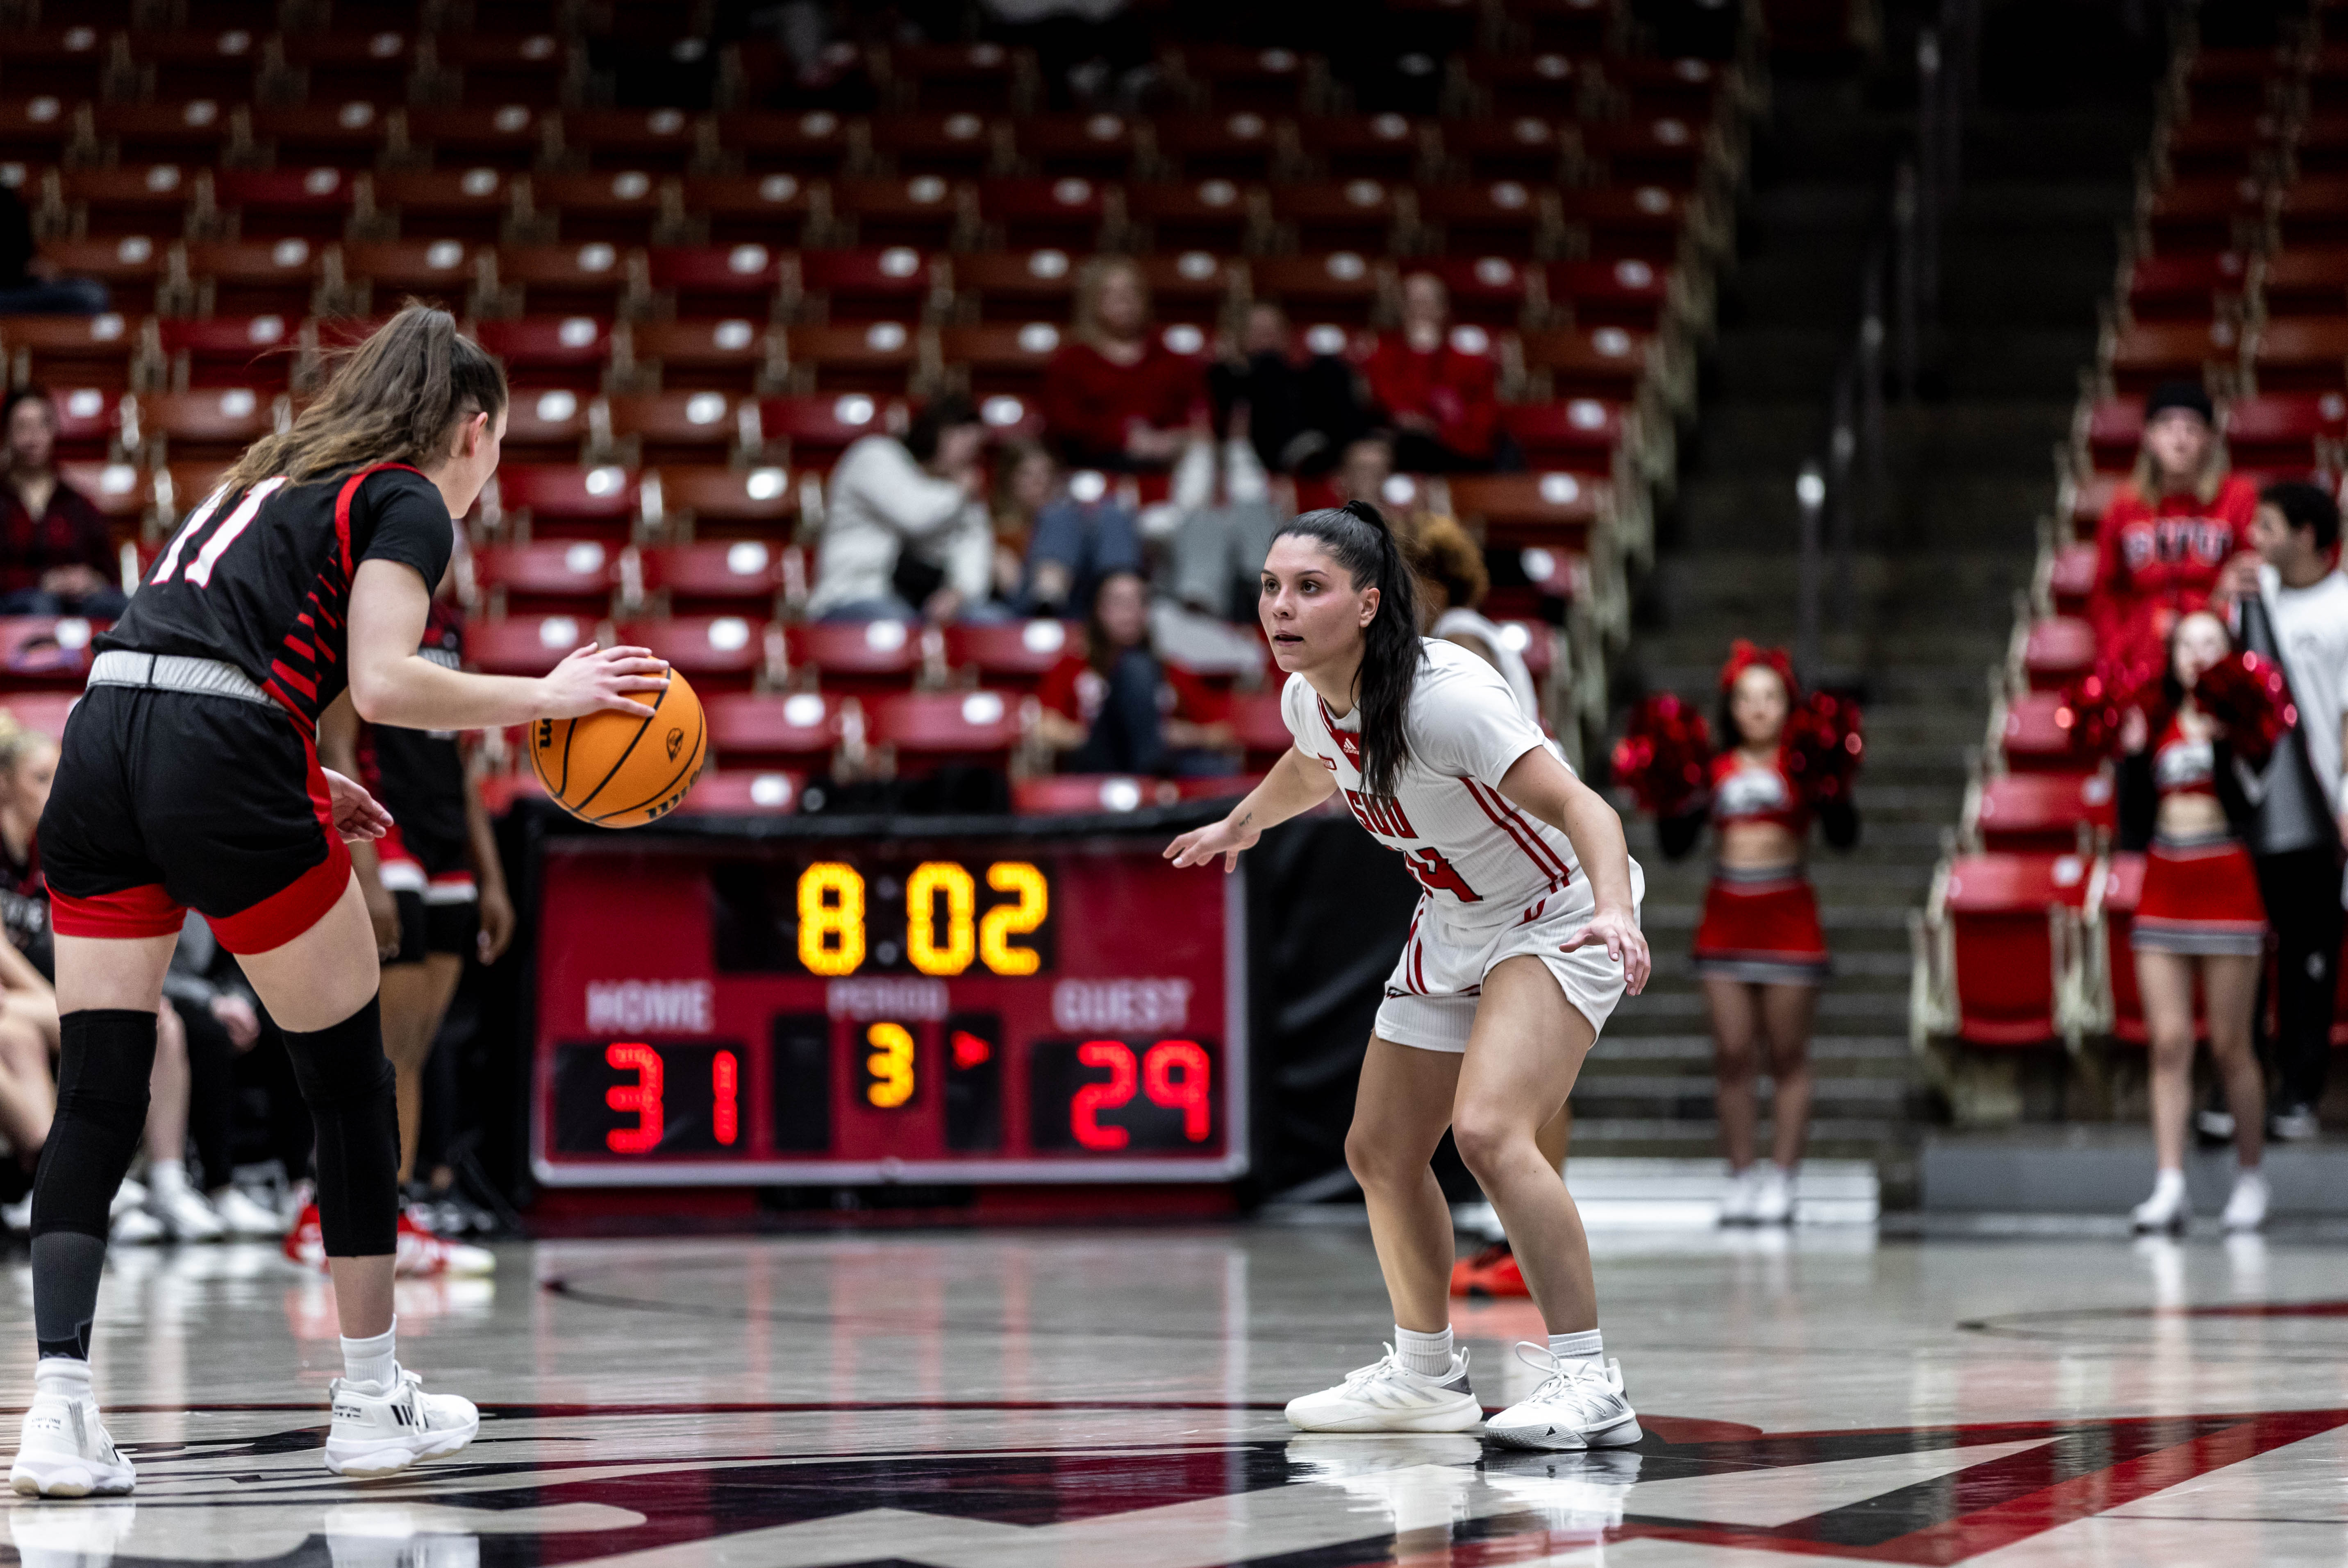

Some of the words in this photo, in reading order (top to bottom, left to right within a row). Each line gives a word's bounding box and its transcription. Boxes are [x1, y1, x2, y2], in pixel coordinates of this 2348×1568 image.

[150, 475, 288, 590] 11
[1345, 788, 1419, 839] SUU
[585, 979, 714, 1034] HOME
[1053, 979, 1191, 1032] GUEST
[605, 1042, 738, 1154] 31
[867, 1022, 915, 1108] 3
[1071, 1040, 1211, 1150] 29
